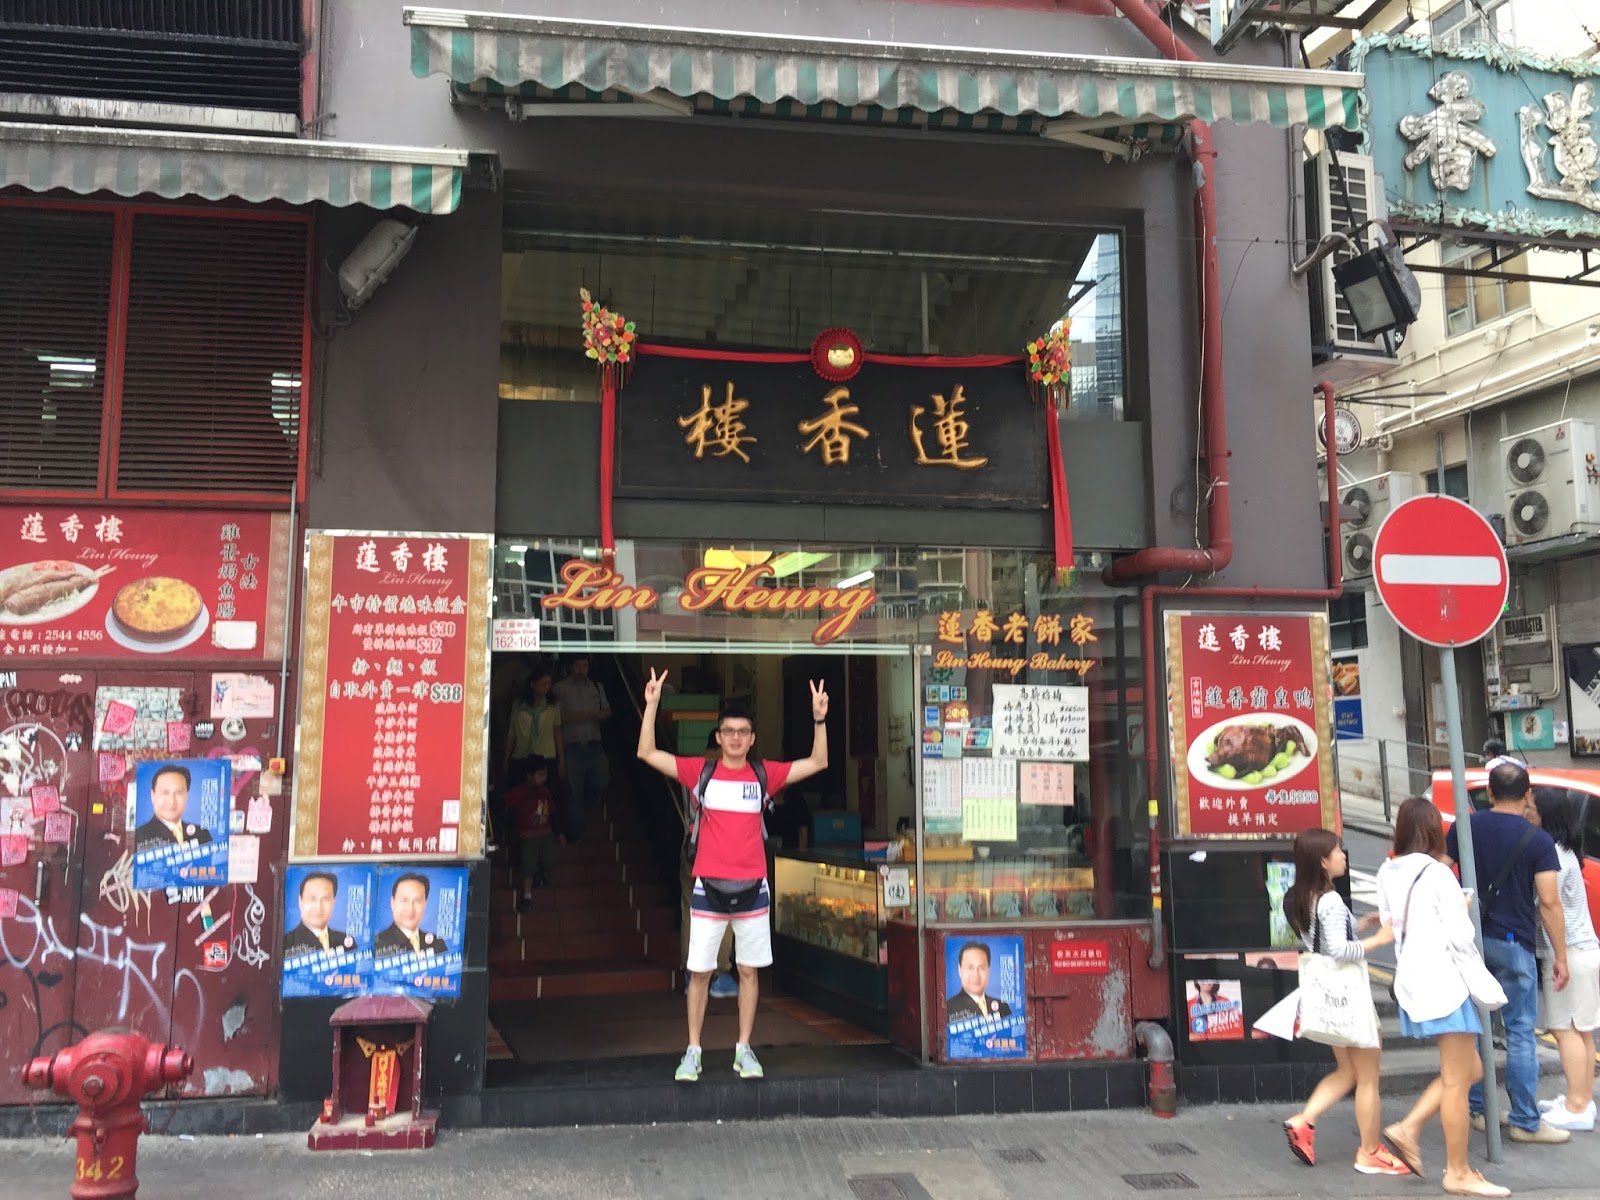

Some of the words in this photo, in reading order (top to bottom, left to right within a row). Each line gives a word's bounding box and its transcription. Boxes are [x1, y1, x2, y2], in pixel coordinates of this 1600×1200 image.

[20, 512, 124, 543] 蓮香樓
[76, 547, 105, 560] Lin
[107, 548, 159, 568] Heung
[356, 540, 449, 573] 蓮香樓
[378, 571, 404, 585] Lin
[407, 572, 453, 593] Heung
[541, 559, 659, 611] Lin
[679, 564, 877, 647] Heung
[45, 629, 72, 641] 2544
[76, 629, 103, 641] 4556
[429, 620, 456, 638] $30
[937, 610, 1098, 646] 蓮香老餅家
[1198, 623, 1283, 652] 蓮香樓
[495, 636, 537, 648] 162-164
[933, 650, 967, 669] Lin
[967, 651, 1028, 675] Heung
[1029, 651, 1095, 676] Bakery
[1229, 654, 1250, 666] Lin
[1251, 655, 1292, 672] Heung
[430, 682, 463, 703] $38
